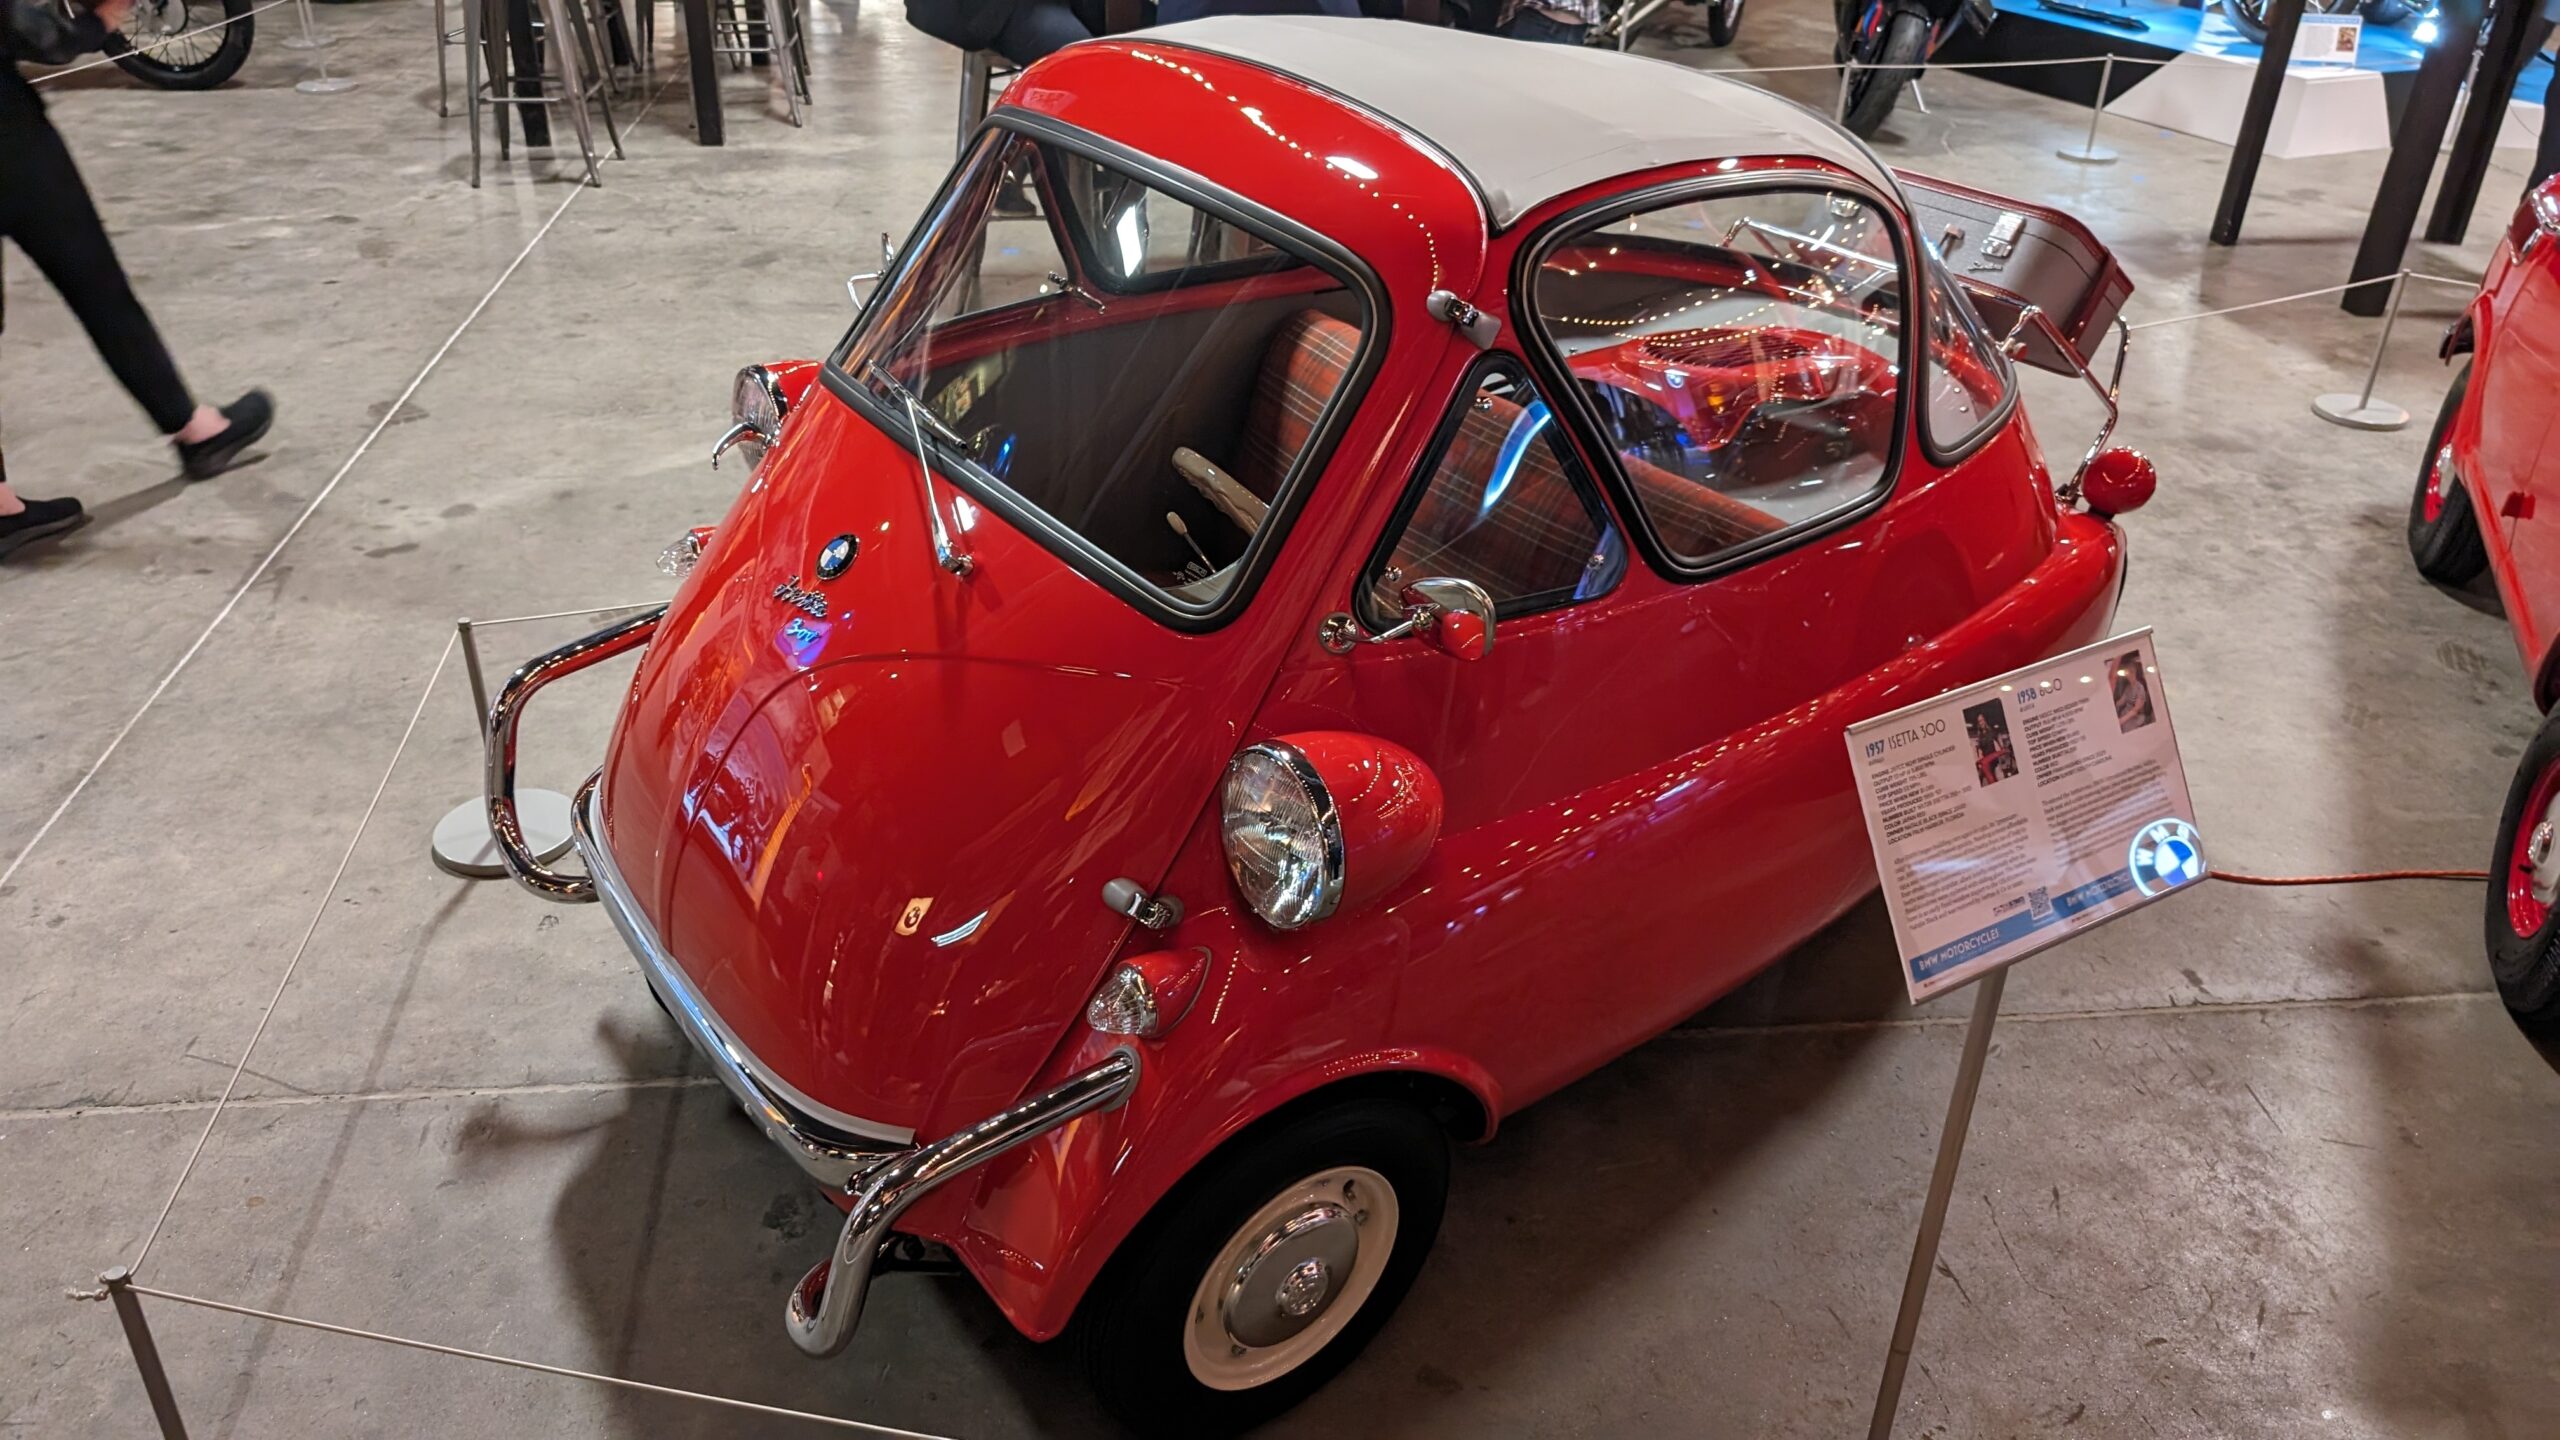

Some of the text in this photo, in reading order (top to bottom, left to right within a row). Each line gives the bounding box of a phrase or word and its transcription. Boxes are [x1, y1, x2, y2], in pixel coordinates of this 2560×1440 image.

[2017, 687, 2037, 704] 1958
[1865, 719, 1946, 758] 1957 ISETTA 300
[1919, 928, 2000, 971] BMW MOTORCYCLES
